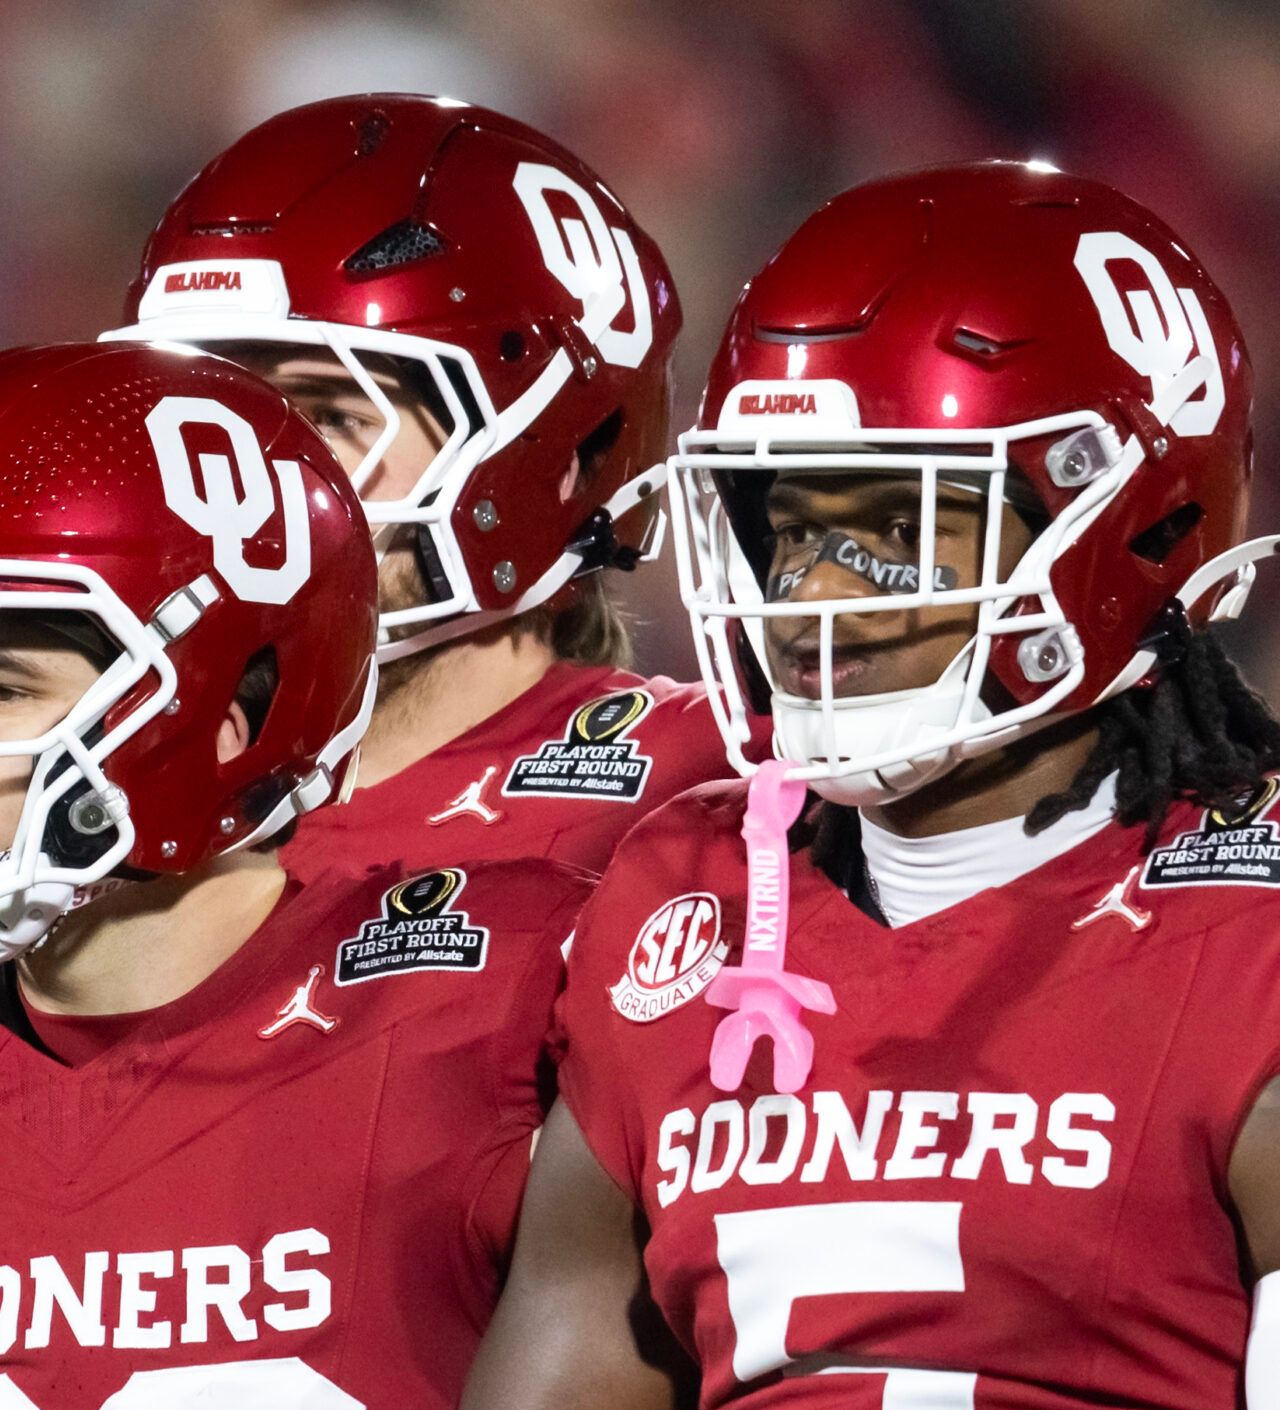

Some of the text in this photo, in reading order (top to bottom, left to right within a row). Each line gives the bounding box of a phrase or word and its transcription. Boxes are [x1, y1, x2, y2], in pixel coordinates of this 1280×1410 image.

[512, 162, 653, 369] OU
[1074, 231, 1226, 436] OU
[146, 396, 311, 604] OU
[836, 539, 947, 589] CONTRL
[543, 745, 627, 759] PLAYOFF
[517, 760, 641, 777] FIRST ROUND
[581, 778, 624, 791] Allstate
[1180, 828, 1268, 848] PLAYOFF
[1154, 847, 1213, 866] FIRST
[1224, 863, 1271, 876] Allstate
[748, 849, 780, 951] NXTRND
[367, 918, 458, 939] PLAYOFF
[637, 900, 713, 984] SEC
[345, 933, 478, 961] FIRST ROUND
[354, 950, 464, 971] PRESENTED BY Allstate
[620, 967, 712, 1018] GRADUATE
[658, 1091, 1116, 1207] SOONERS
